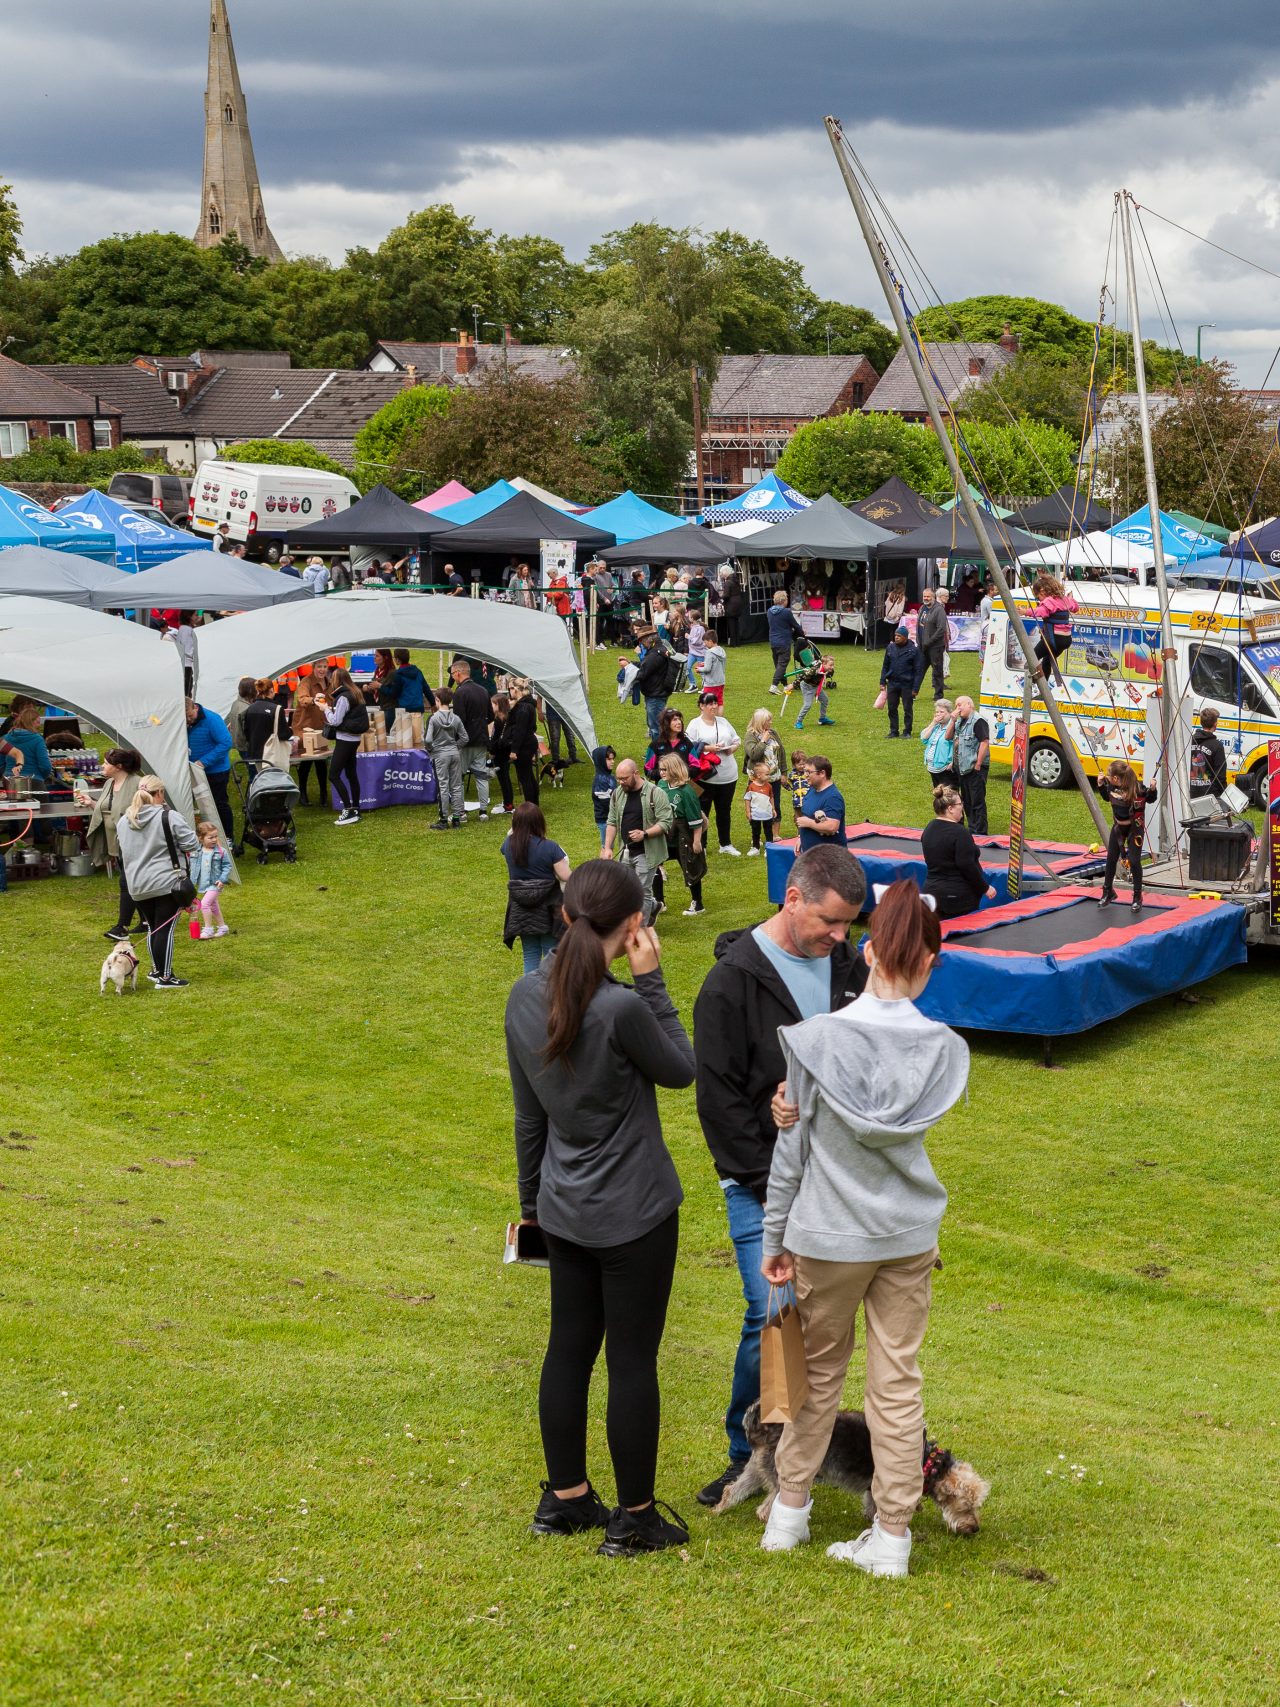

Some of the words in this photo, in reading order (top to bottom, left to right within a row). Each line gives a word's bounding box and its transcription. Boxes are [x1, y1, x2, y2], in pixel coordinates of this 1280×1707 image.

[1076, 608, 1100, 617] AVE'S
[1102, 609, 1140, 619] WHIPPY
[1197, 615, 1216, 624] 99
[384, 769, 432, 782] Scouts
